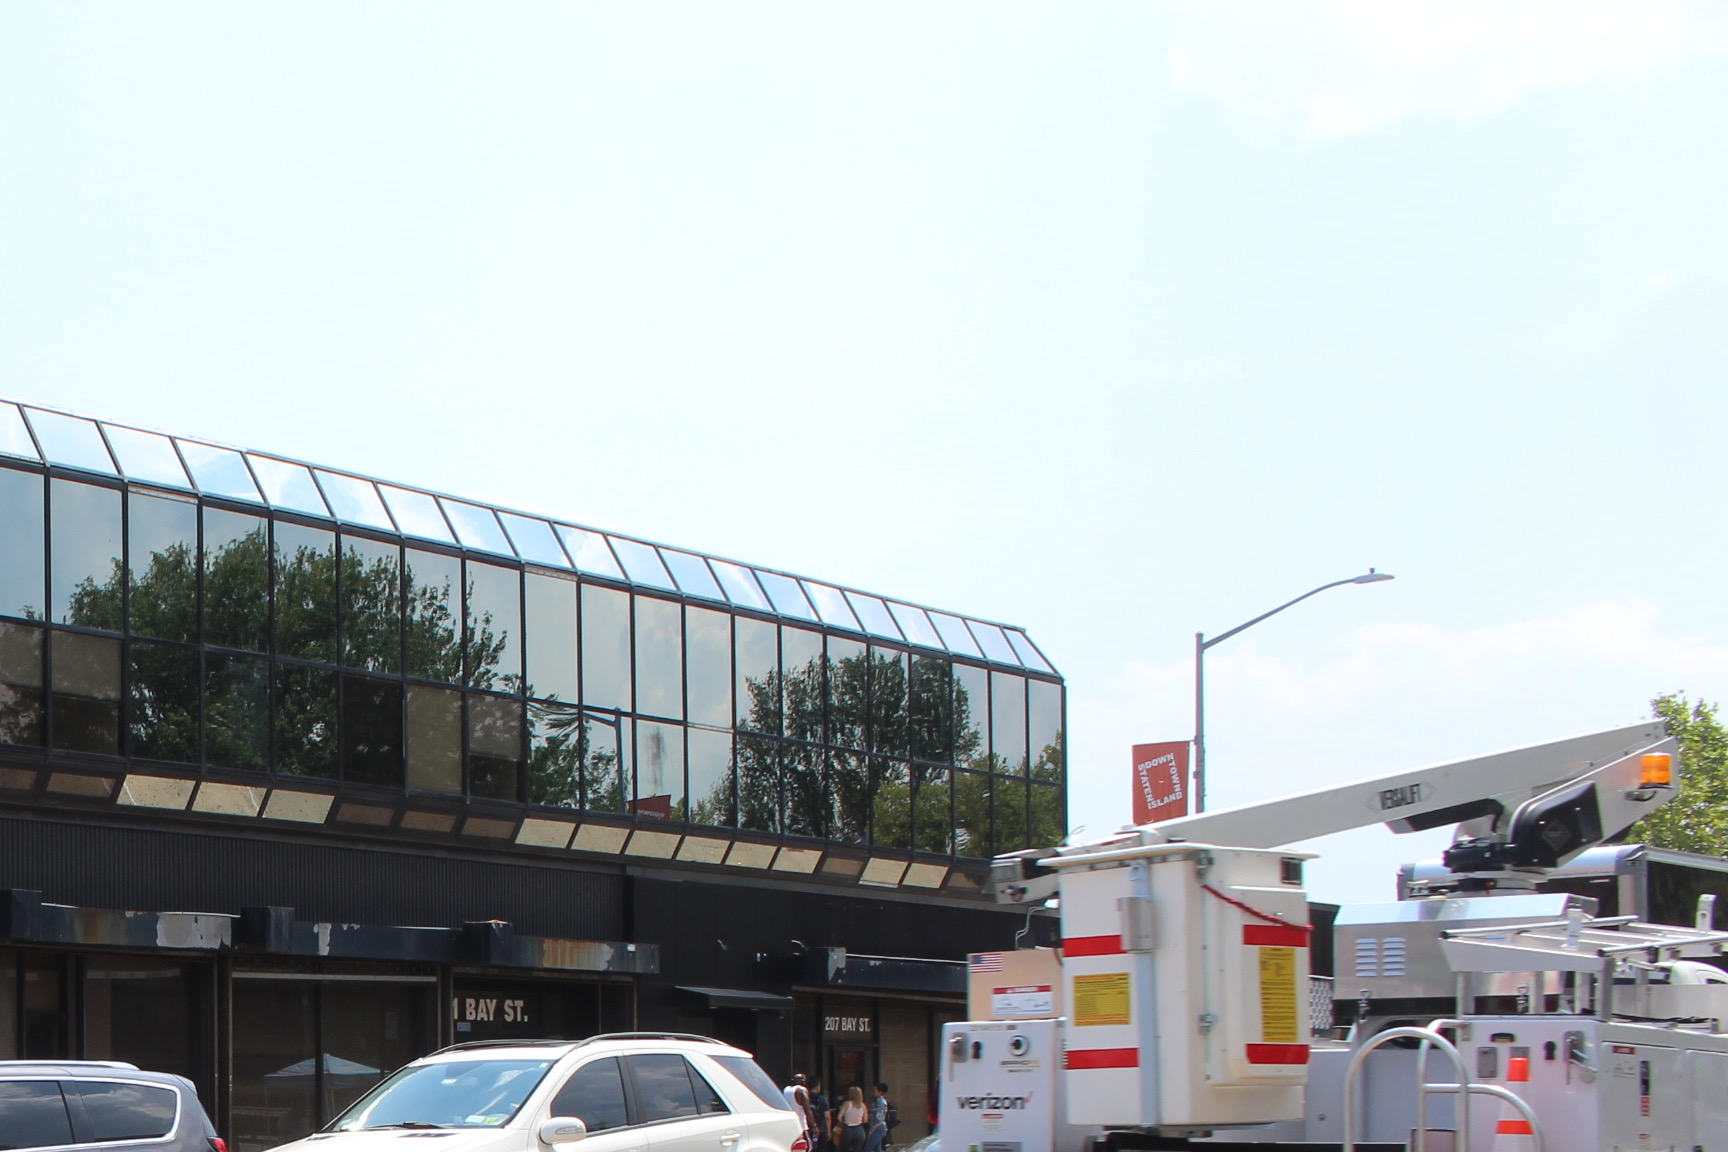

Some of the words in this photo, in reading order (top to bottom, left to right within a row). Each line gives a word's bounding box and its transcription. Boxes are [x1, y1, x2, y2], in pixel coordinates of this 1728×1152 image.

[1145, 753, 1175, 770] DOWN
[1148, 792, 1183, 809] ISLAND
[466, 998, 497, 1021] BAY
[504, 999, 528, 1022] ST.
[825, 1016, 840, 1031] 207
[841, 1017, 857, 1031] BAY
[858, 1018, 871, 1032] ST.
[956, 1093, 1025, 1110] verizon
